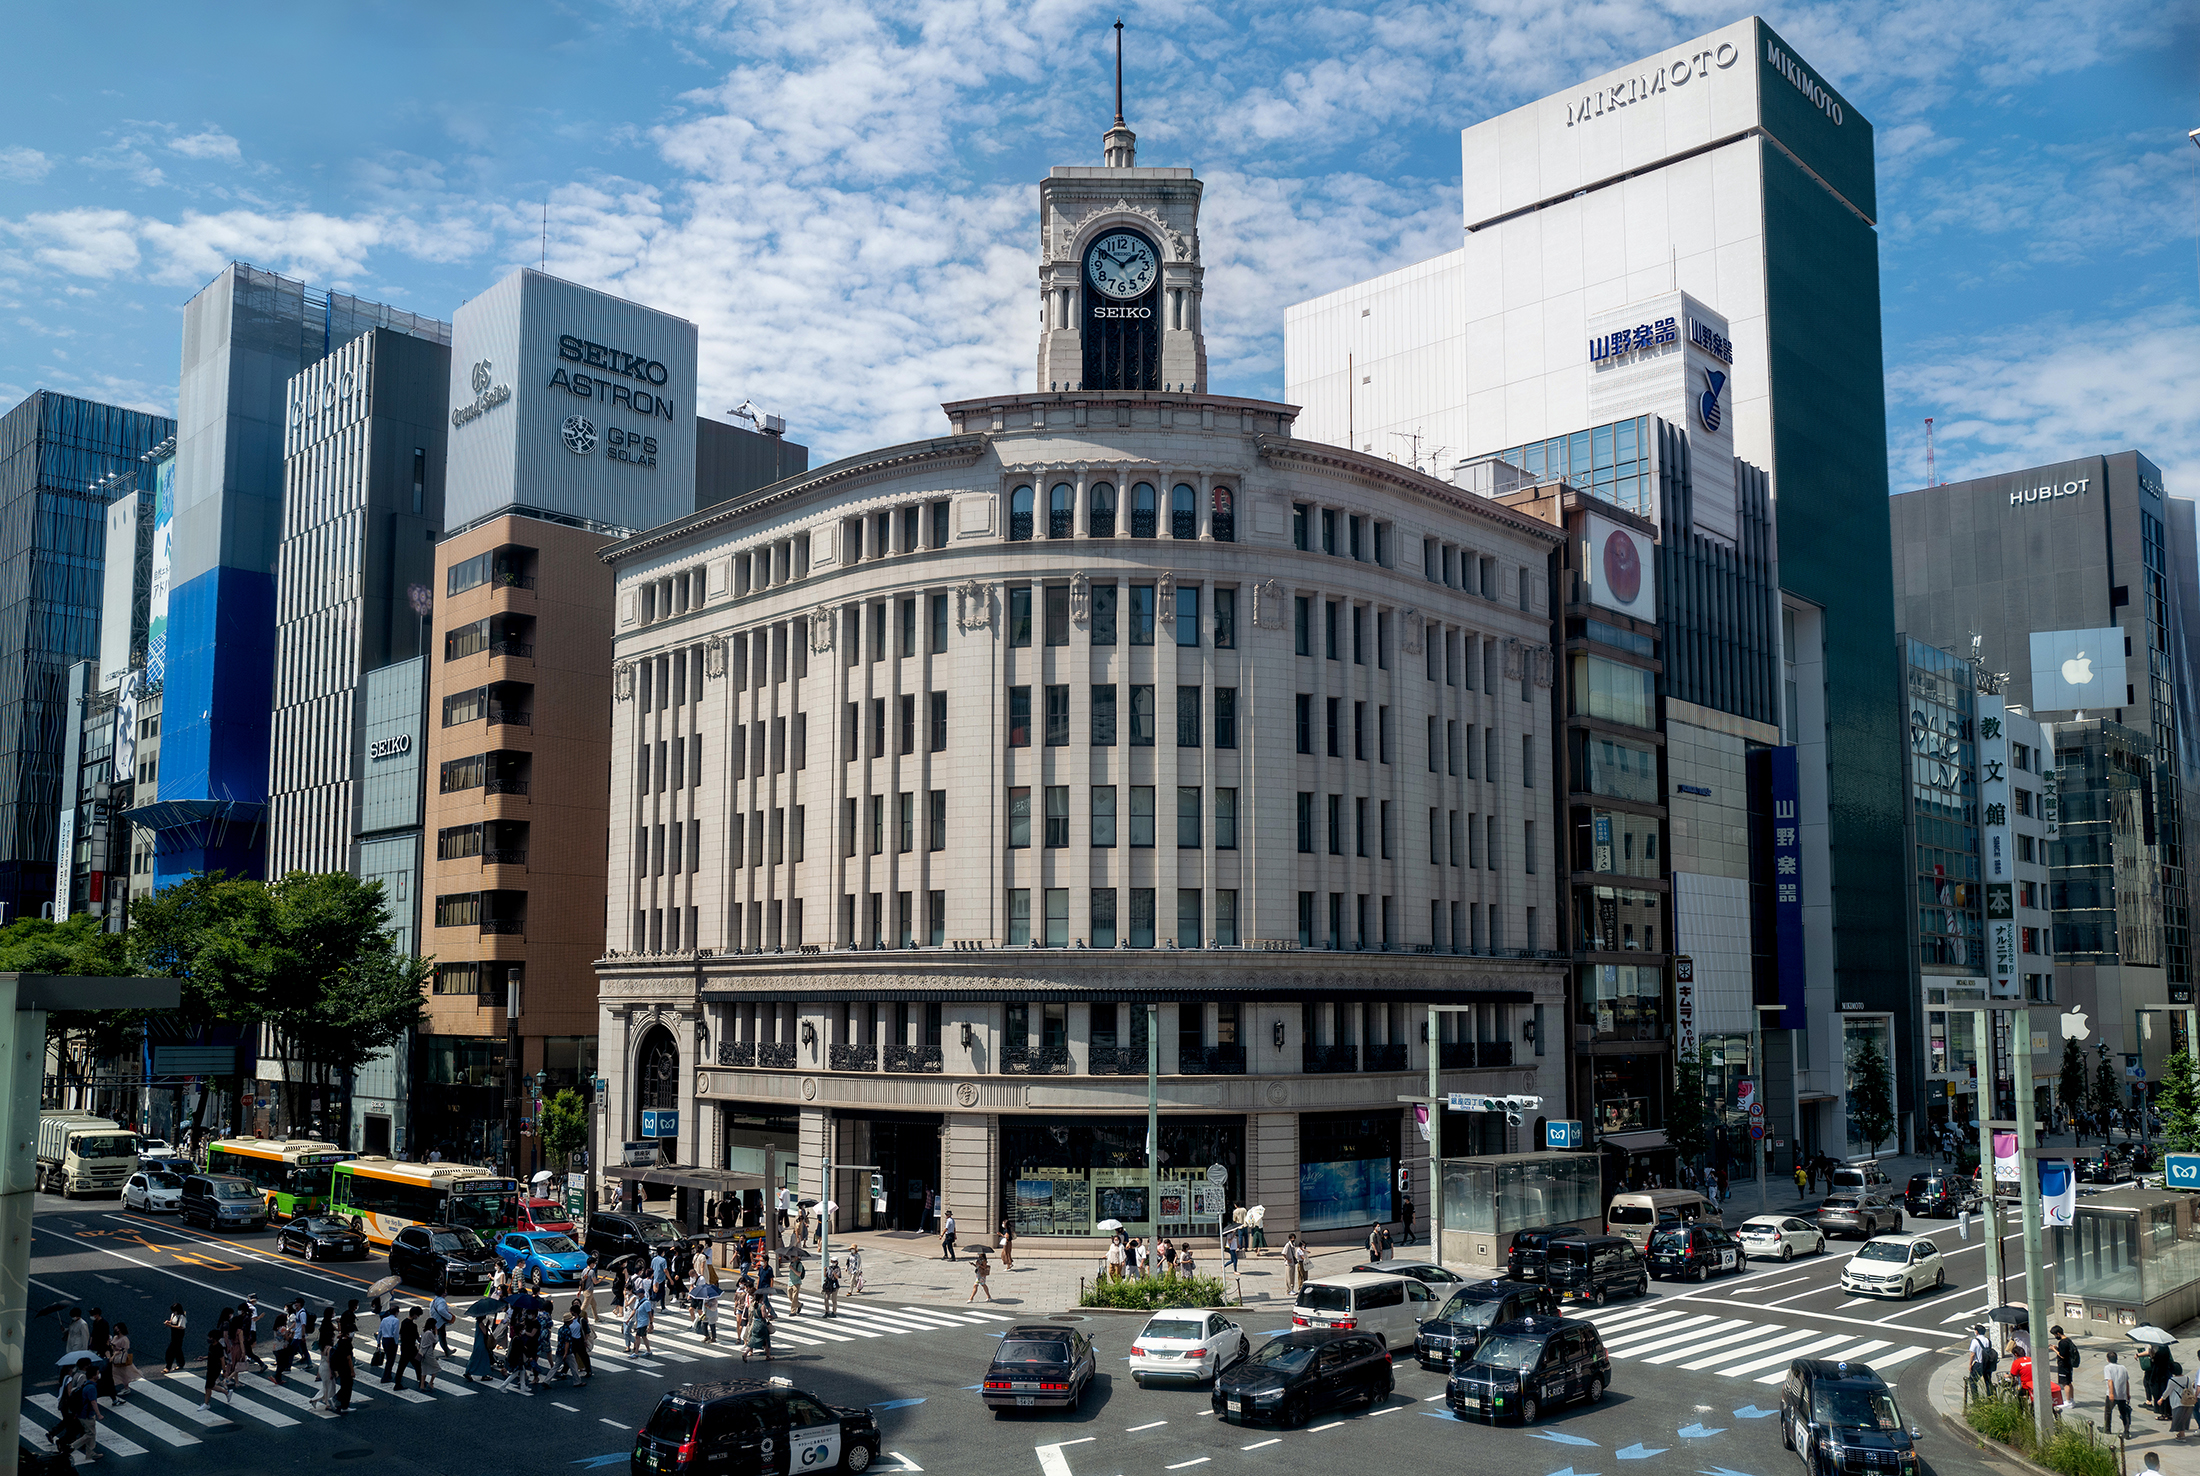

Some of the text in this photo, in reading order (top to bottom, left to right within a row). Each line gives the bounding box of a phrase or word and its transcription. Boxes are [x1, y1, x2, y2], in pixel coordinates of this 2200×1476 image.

[1565, 40, 1739, 128] MIKIMOTO
[1766, 38, 1843, 127] MIKIMOTO
[1107, 240, 1116, 252] 11
[1117, 238, 1128, 250] 12
[1131, 241, 1136, 252] 1
[1138, 249, 1147, 260] 2
[1094, 260, 1103, 271] 9
[1098, 271, 1107, 282] 8
[1137, 271, 1146, 282] 4
[1142, 260, 1150, 271] 3
[1108, 278, 1117, 289] 7
[1117, 281, 1127, 292] 6
[1129, 279, 1137, 290] 5
[1094, 307, 1151, 319] SEIKO
[1589, 316, 1677, 363] 山野楽器
[1688, 315, 1734, 365] 山野楽器
[558, 334, 668, 387] SEIKO
[289, 363, 370, 431] GUCCI
[451, 382, 512, 429] Grand Seiko
[547, 367, 674, 423] ASTRON
[606, 425, 658, 455] GPS
[605, 447, 658, 470] SOLAR
[2009, 478, 2092, 507] HUBLOT
[2140, 473, 2163, 502] HUBLOT
[153, 565, 171, 581] 自然エネ
[369, 733, 412, 760] SEIKO
[1980, 716, 2007, 827] 教文館
[2043, 769, 2058, 835] 教文館ビル
[1775, 799, 1797, 904] 山野楽器
[1993, 835, 2002, 858] SINCE
[1988, 888, 2011, 915] 本
[1995, 925, 2009, 975] ナルニア国
[1841, 1001, 1865, 1011] MIKIMOTO
[2032, 1037, 2048, 1048] FURLA
[1737, 1087, 1747, 1111] 2020
[801, 1444, 829, 1466] GO
